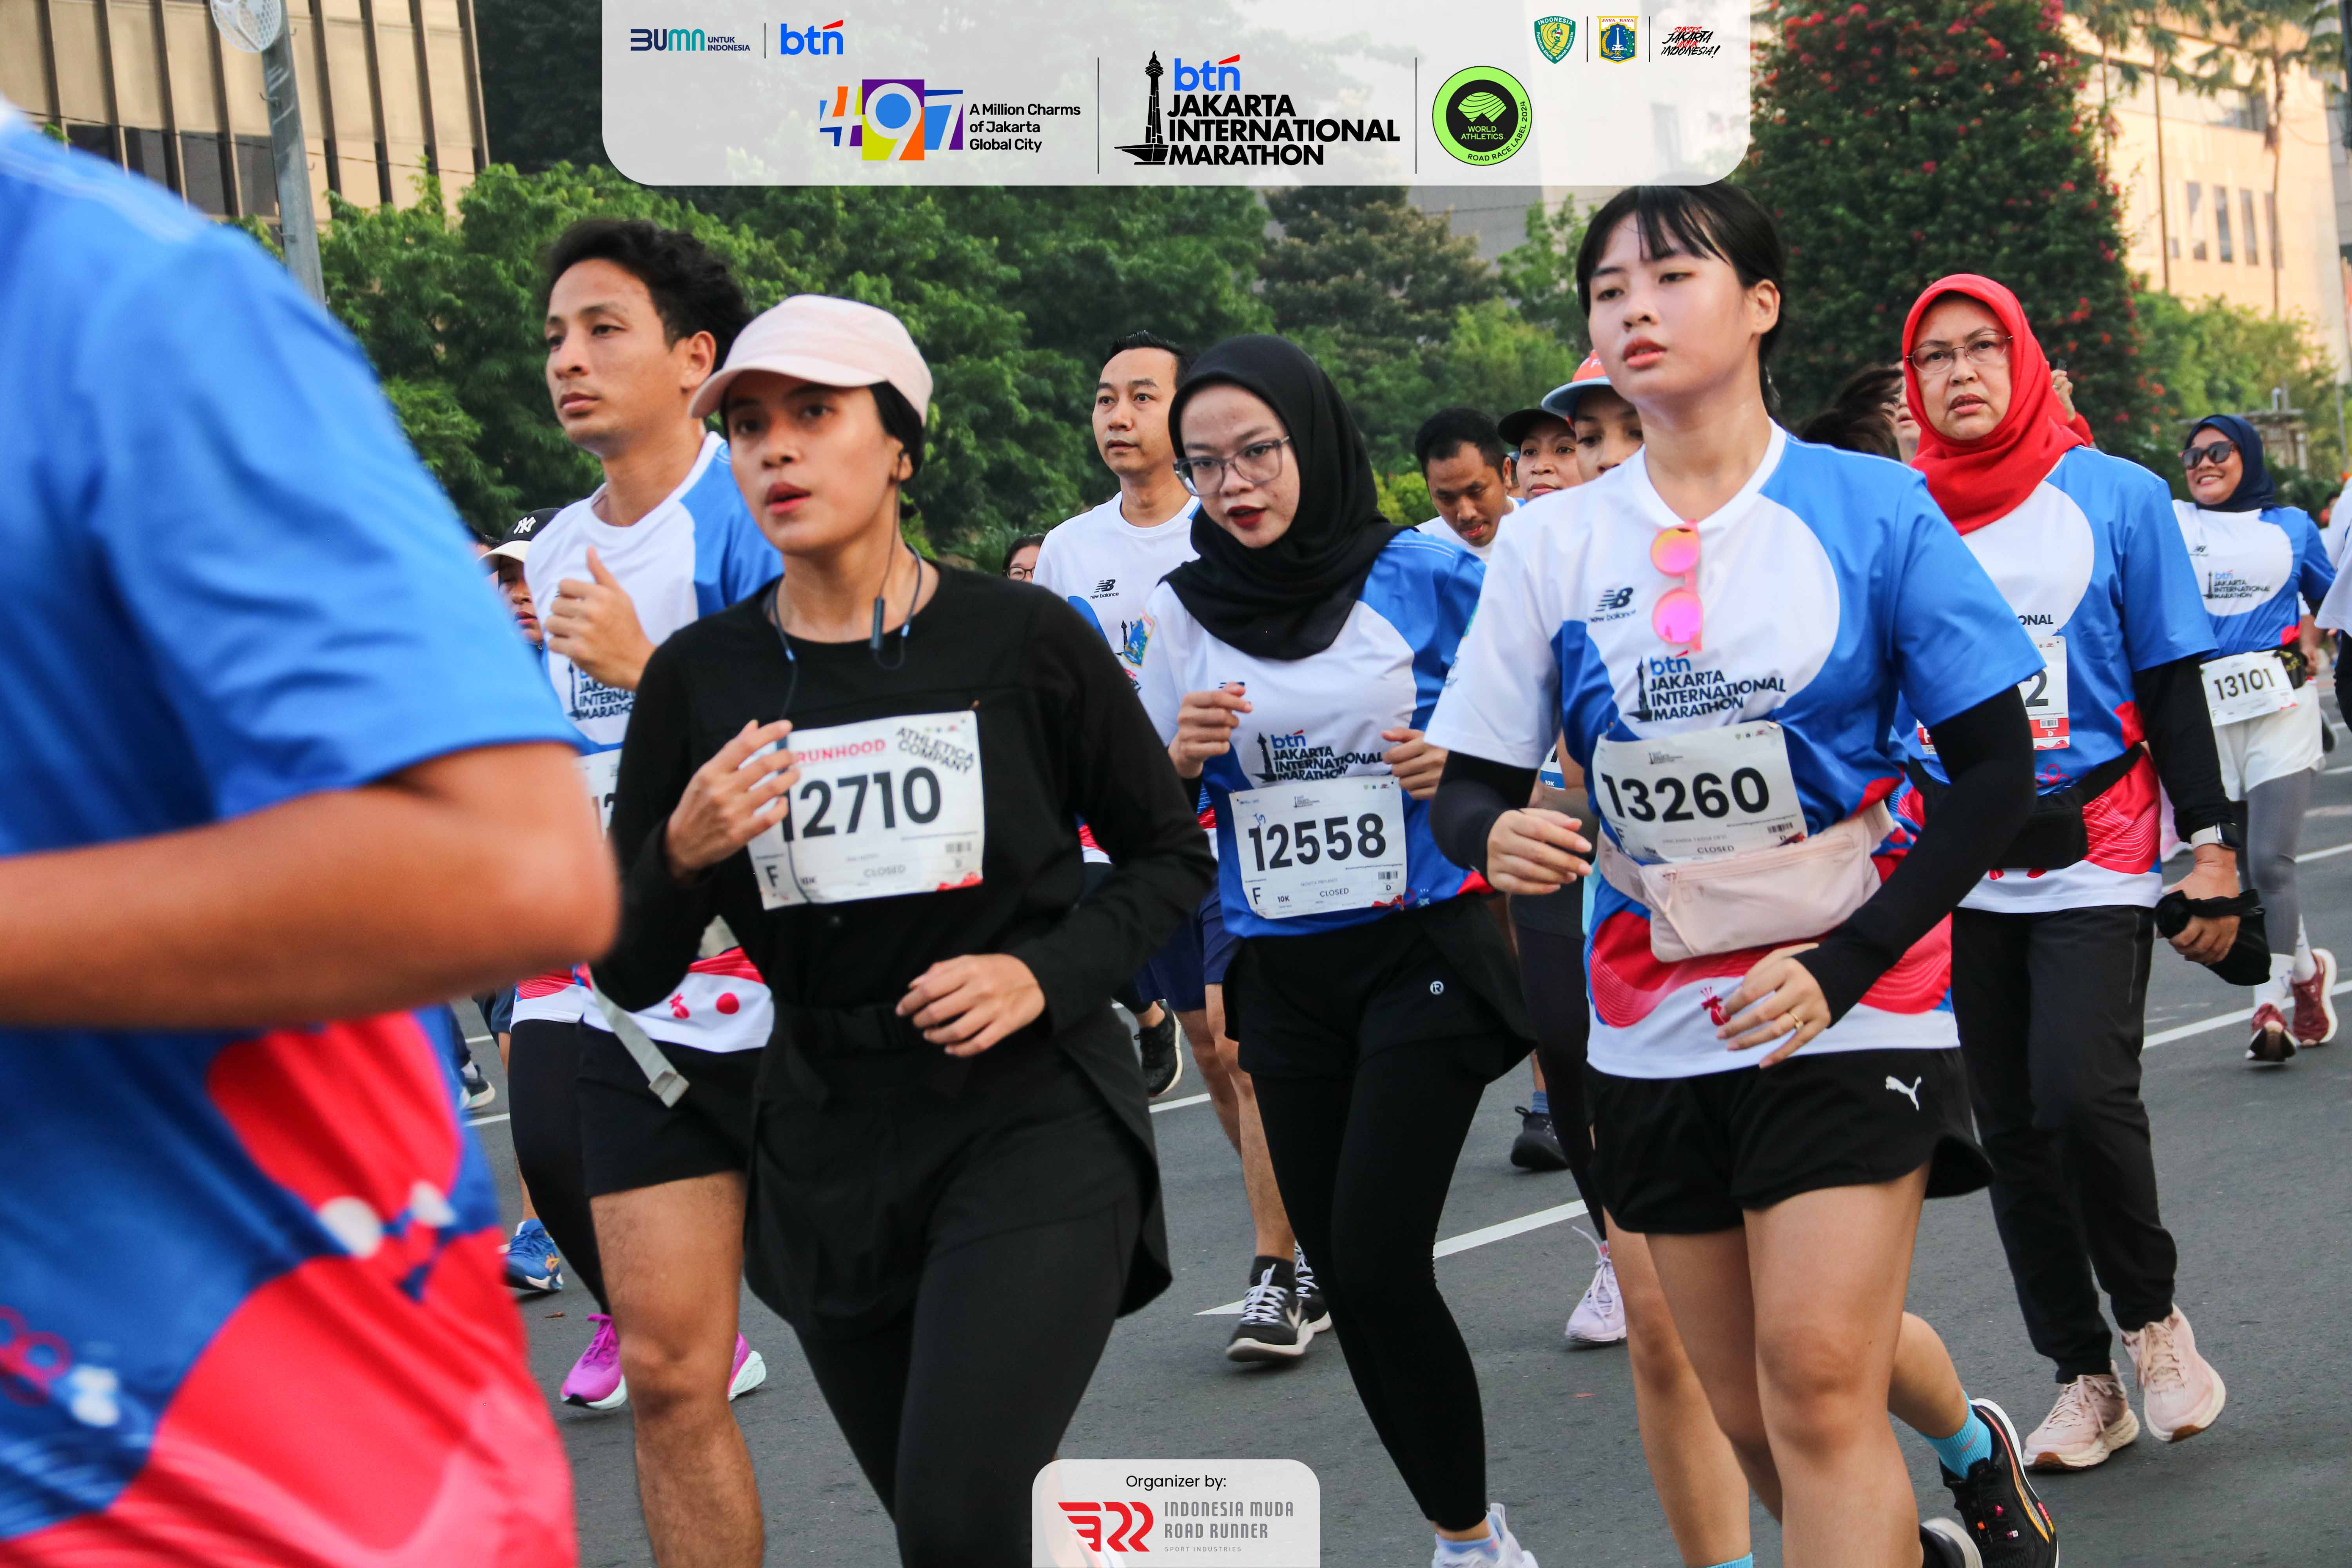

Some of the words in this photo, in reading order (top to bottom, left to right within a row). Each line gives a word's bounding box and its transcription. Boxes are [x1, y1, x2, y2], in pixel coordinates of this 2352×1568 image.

[1650, 650, 1691, 675] btn
[1650, 670, 1725, 691] JAKARTA
[2214, 668, 2275, 700] 13101
[1651, 677, 1786, 706] INTERNATIONAL
[1654, 697, 1743, 721] MARATHON
[1271, 729, 1306, 749] btn
[1273, 746, 1334, 760] JAKARTA
[1275, 751, 1383, 772] INTERNATIONAL
[1277, 764, 1348, 780] MARATHON
[1601, 767, 1770, 823] 13260
[1248, 812, 1387, 872] 12558
[1697, 845, 1735, 854] CLOSED
[766, 865, 777, 887] F
[864, 864, 906, 878] CLOSED
[1252, 887, 1261, 905] F
[1319, 887, 1349, 897] CLOSED
